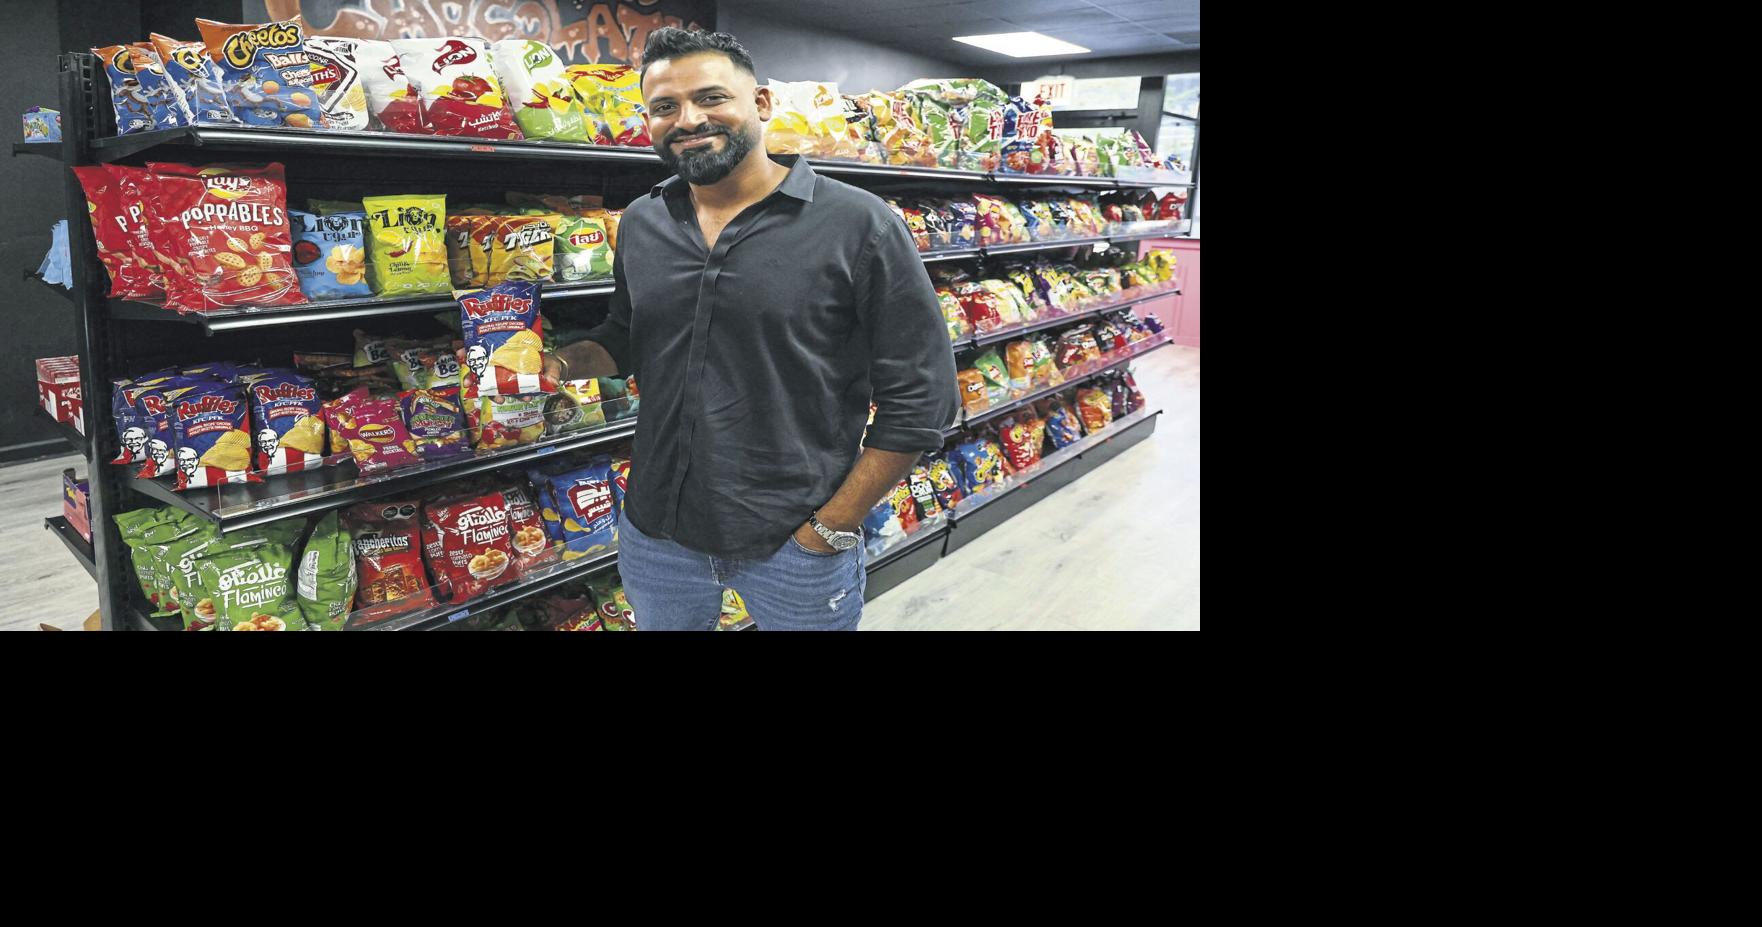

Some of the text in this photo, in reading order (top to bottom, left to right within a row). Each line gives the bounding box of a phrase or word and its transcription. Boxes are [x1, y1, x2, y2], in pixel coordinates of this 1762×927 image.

[222, 24, 299, 69] Cheetos
[523, 46, 551, 69] LION
[1040, 83, 1065, 98] EXIT
[181, 202, 283, 230] POPPABLES
[504, 228, 552, 250] TIGER
[461, 294, 533, 320] Ruffles
[255, 382, 316, 405] Ruffles
[177, 395, 238, 421] Ruffles
[361, 428, 394, 437] WALKERS
